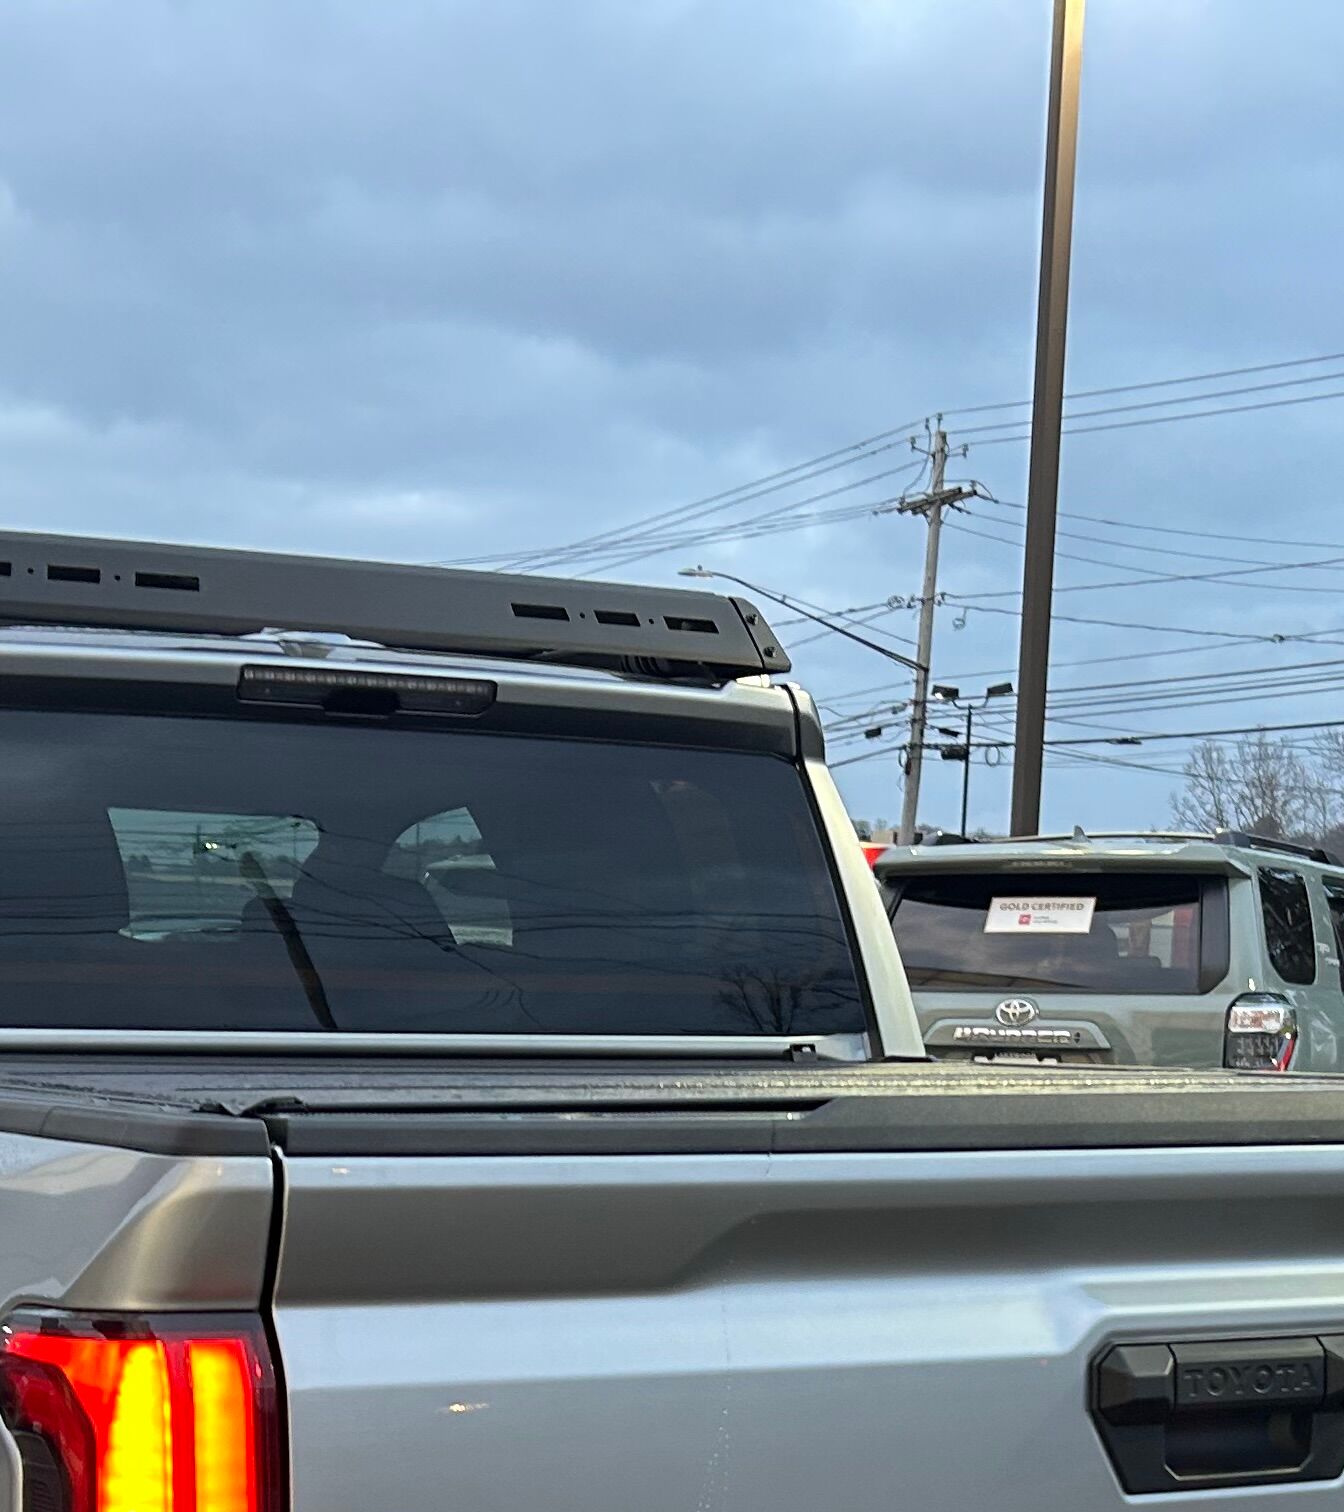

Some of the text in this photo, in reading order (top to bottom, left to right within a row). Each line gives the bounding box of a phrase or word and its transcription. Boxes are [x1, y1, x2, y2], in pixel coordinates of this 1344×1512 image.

[999, 902, 1085, 911] GOLD CERTIFIED
[1183, 1361, 1318, 1397] TOYOTA
